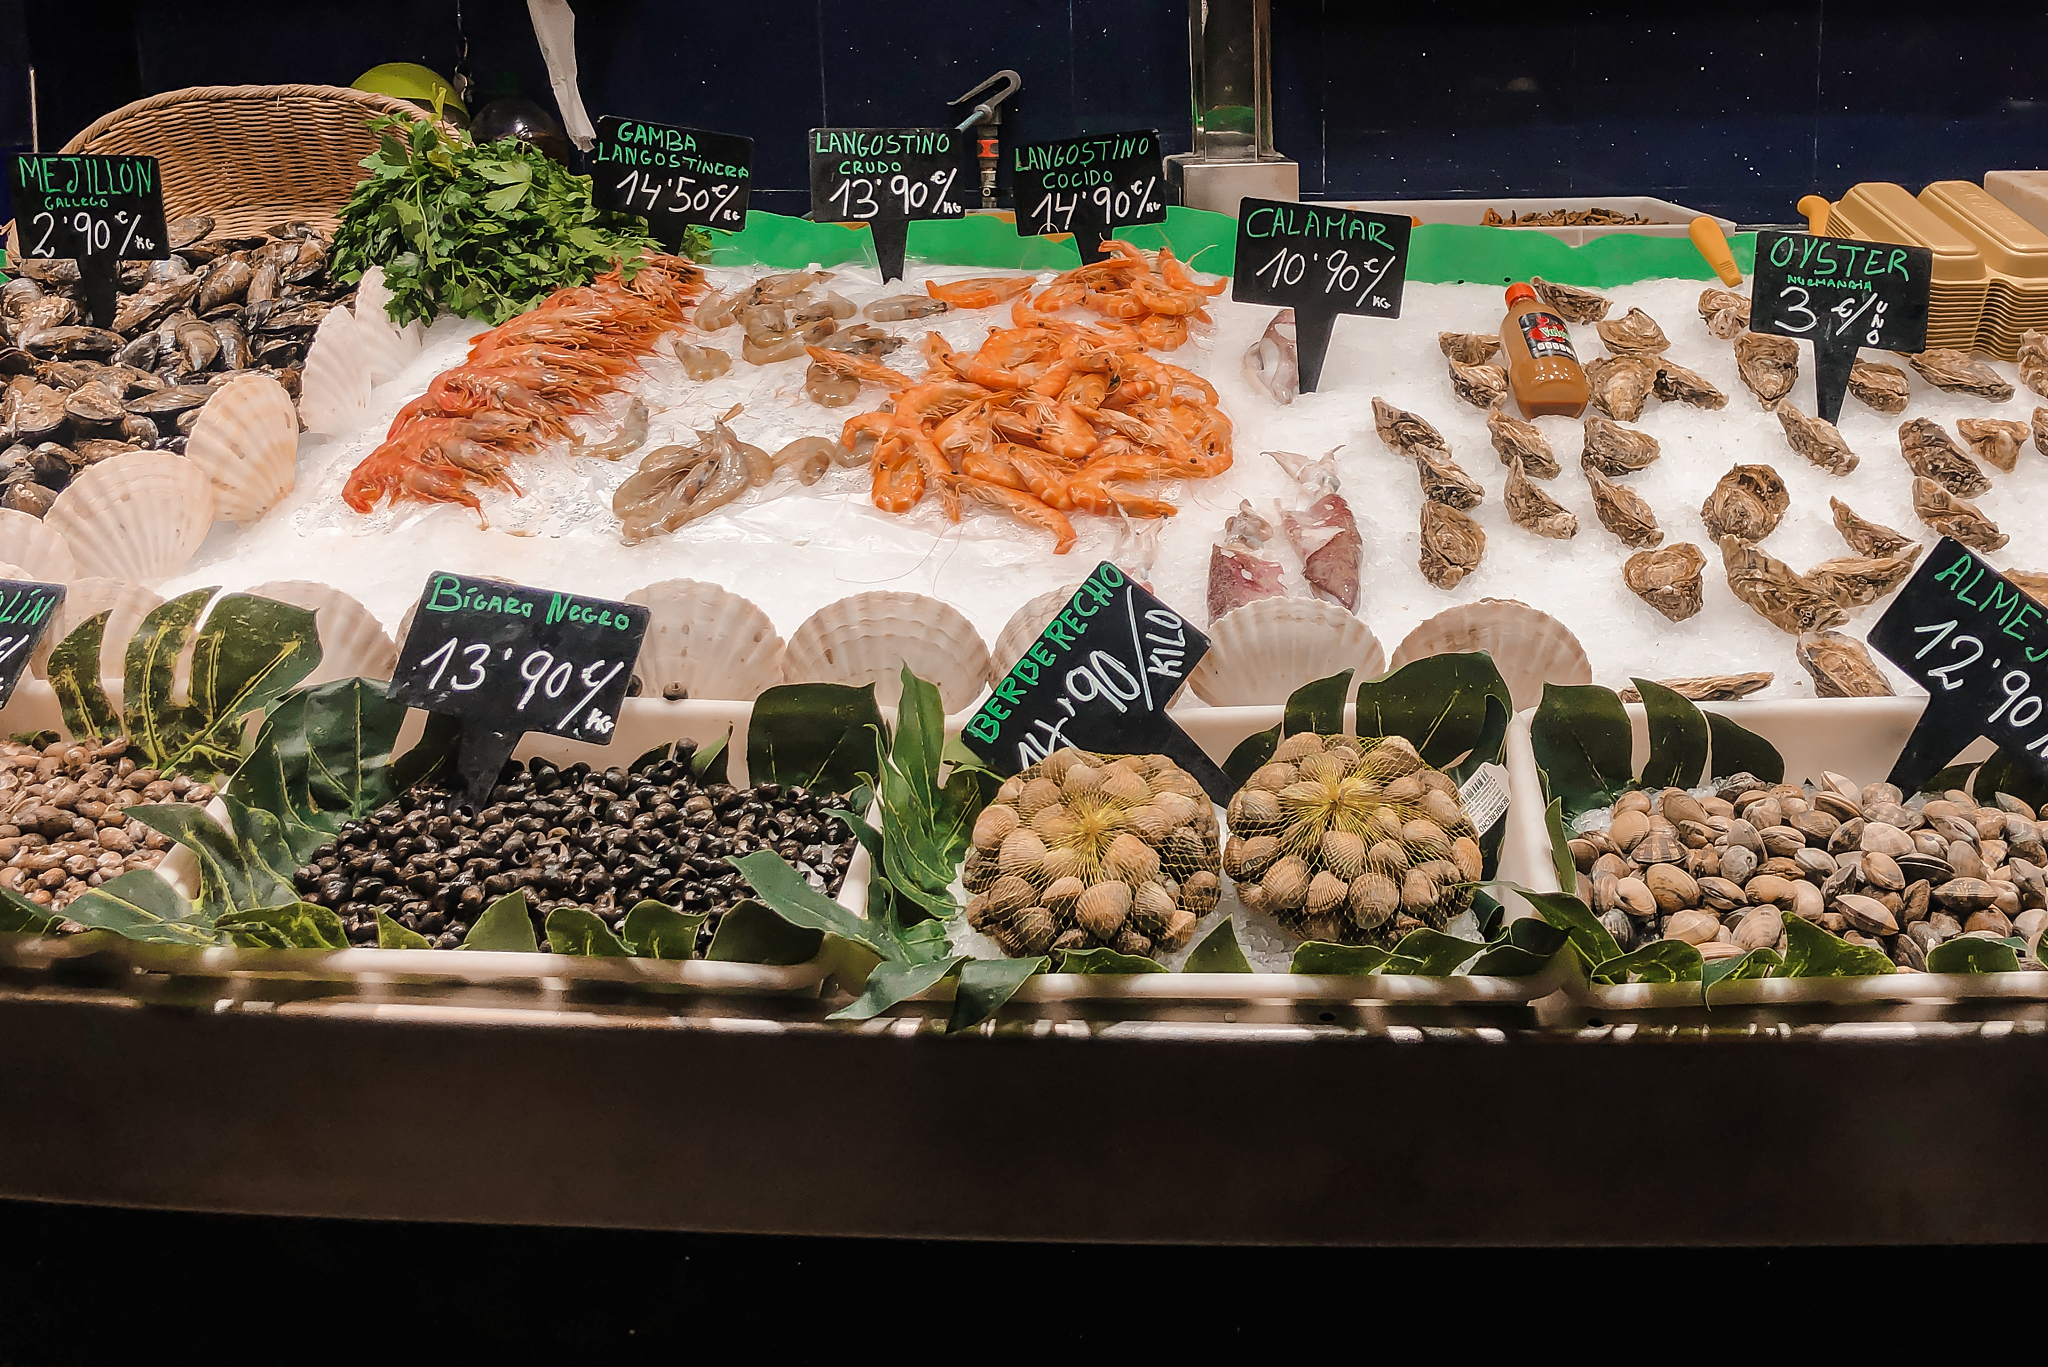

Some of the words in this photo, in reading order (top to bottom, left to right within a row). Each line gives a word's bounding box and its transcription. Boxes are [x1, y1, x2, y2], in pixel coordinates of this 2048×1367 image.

[617, 121, 696, 152] GAMBA
[815, 129, 950, 158] LANGOSTINO
[838, 160, 902, 175] CRUDO
[1015, 134, 1149, 172] LANGOSTINO
[1042, 169, 1113, 189] COCIDO
[44, 196, 109, 210] GALLEGO
[1246, 207, 1394, 251] CALAMAR
[1770, 235, 1910, 282] OYSTER
[966, 562, 1125, 744] BERBERECHO
